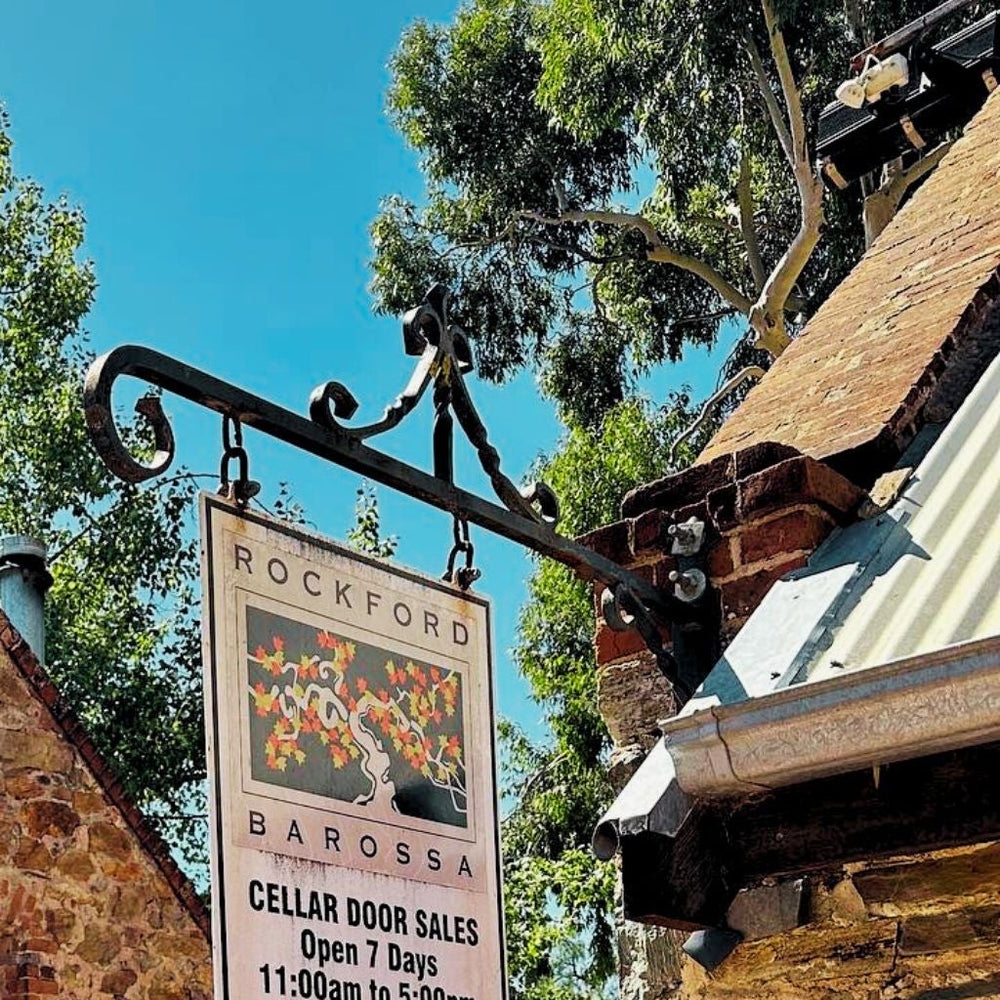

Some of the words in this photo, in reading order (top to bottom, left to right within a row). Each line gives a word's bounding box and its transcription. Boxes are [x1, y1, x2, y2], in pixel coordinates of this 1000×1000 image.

[234, 544, 469, 646] ROCKFORD
[249, 811, 473, 877] BAROSSA
[249, 879, 339, 923] CELLAR
[347, 898, 408, 935] DOOR
[415, 910, 479, 946] SALES
[300, 929, 358, 967] Open
[366, 940, 379, 967] 7
[388, 943, 438, 981] Days
